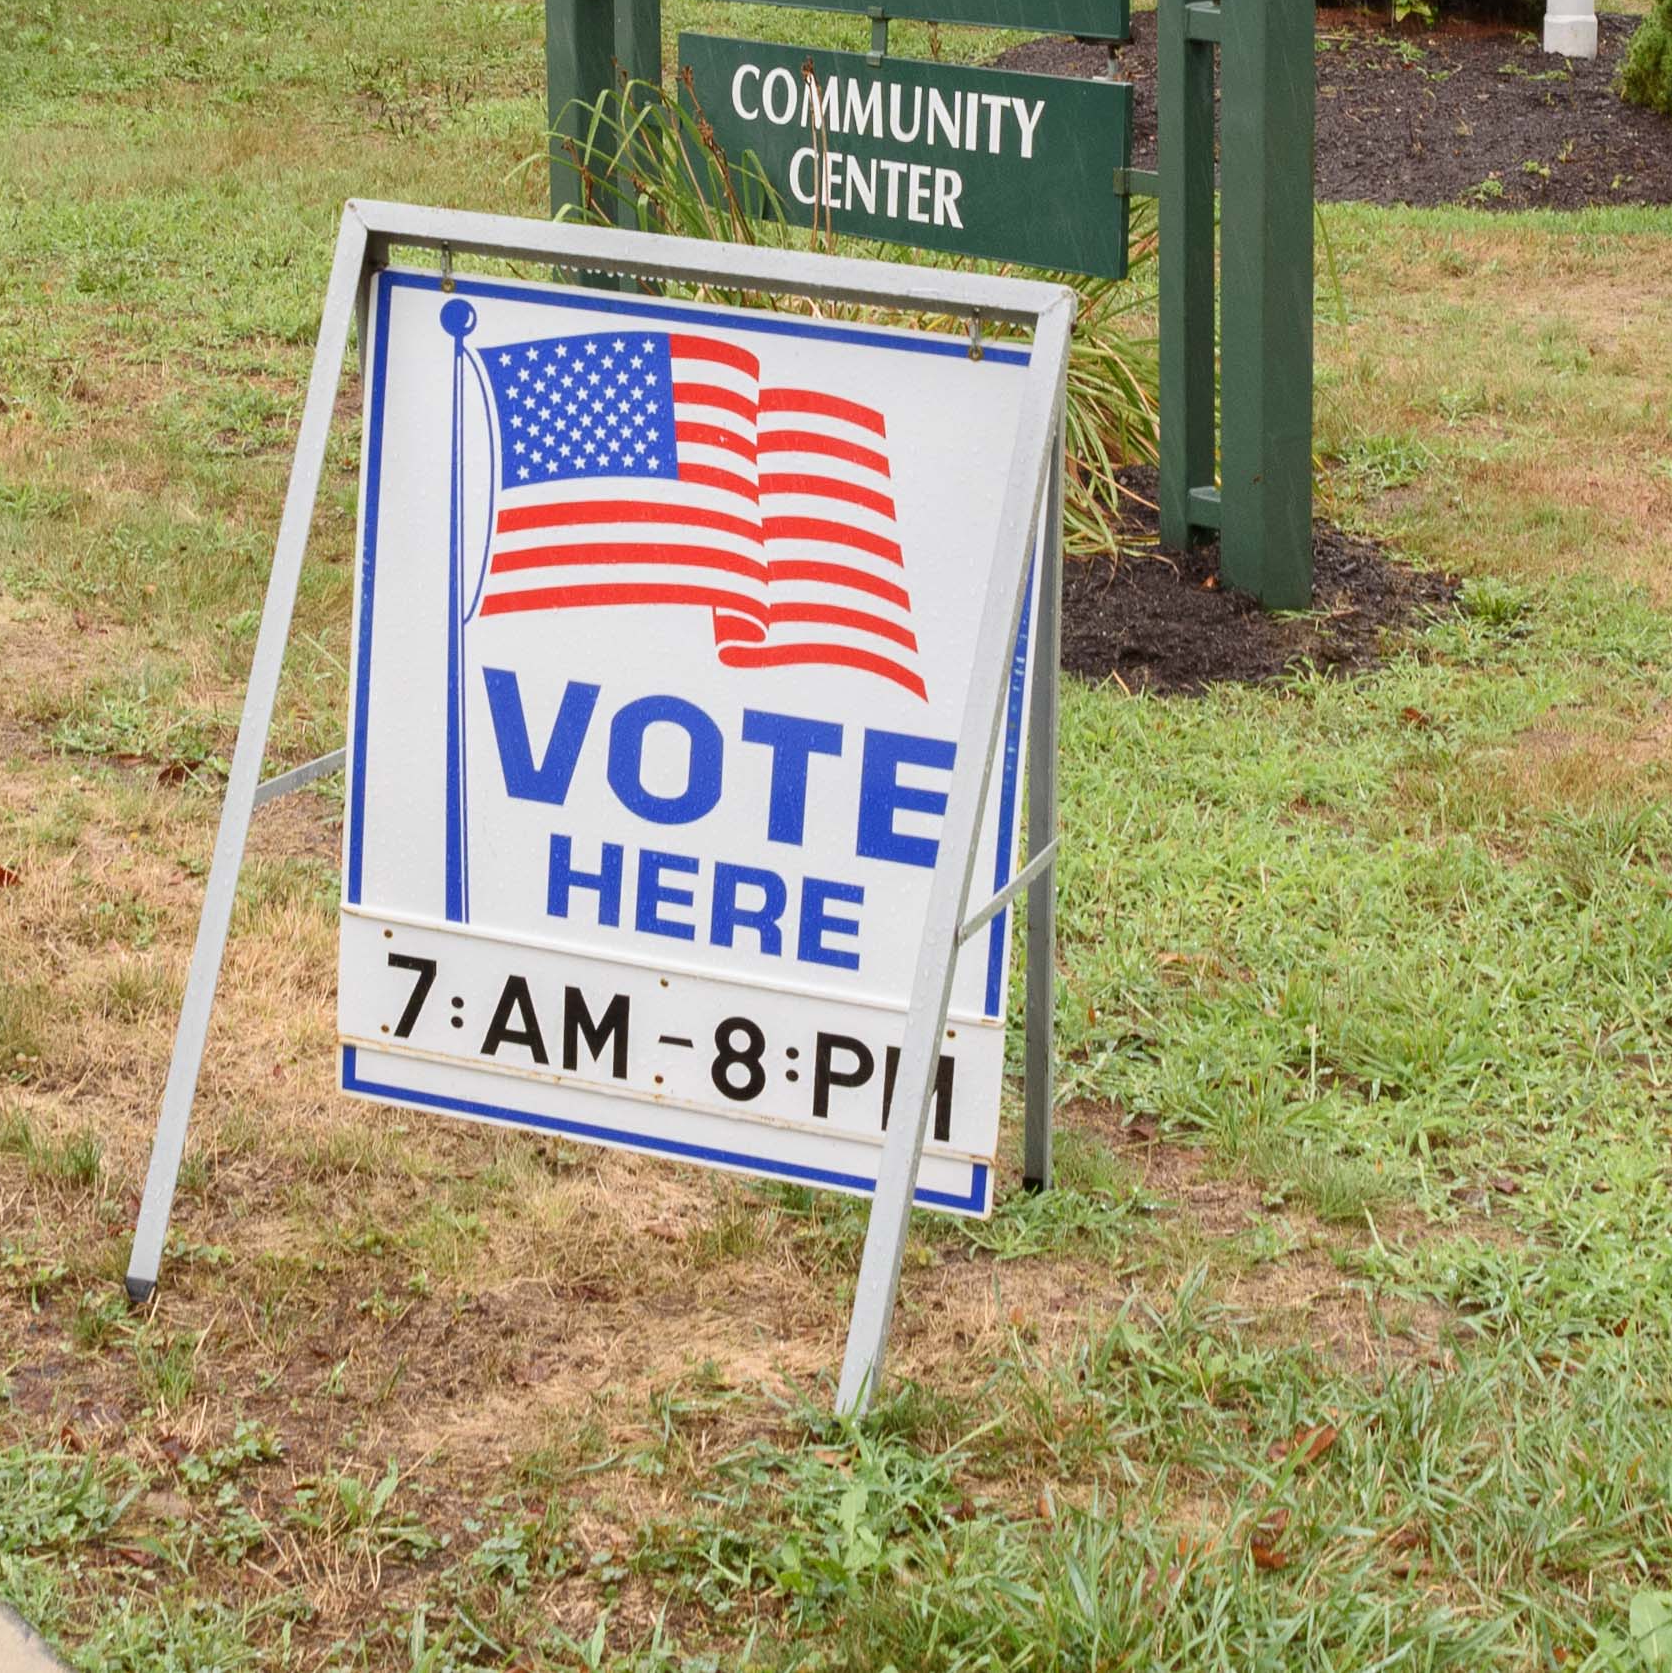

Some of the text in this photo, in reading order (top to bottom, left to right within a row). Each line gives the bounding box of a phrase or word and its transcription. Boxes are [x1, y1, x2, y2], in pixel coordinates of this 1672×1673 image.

[731, 63, 1046, 159] COMMUNITY
[788, 146, 965, 230] CENTER
[481, 666, 958, 869] VOTE
[546, 833, 865, 971] HERE
